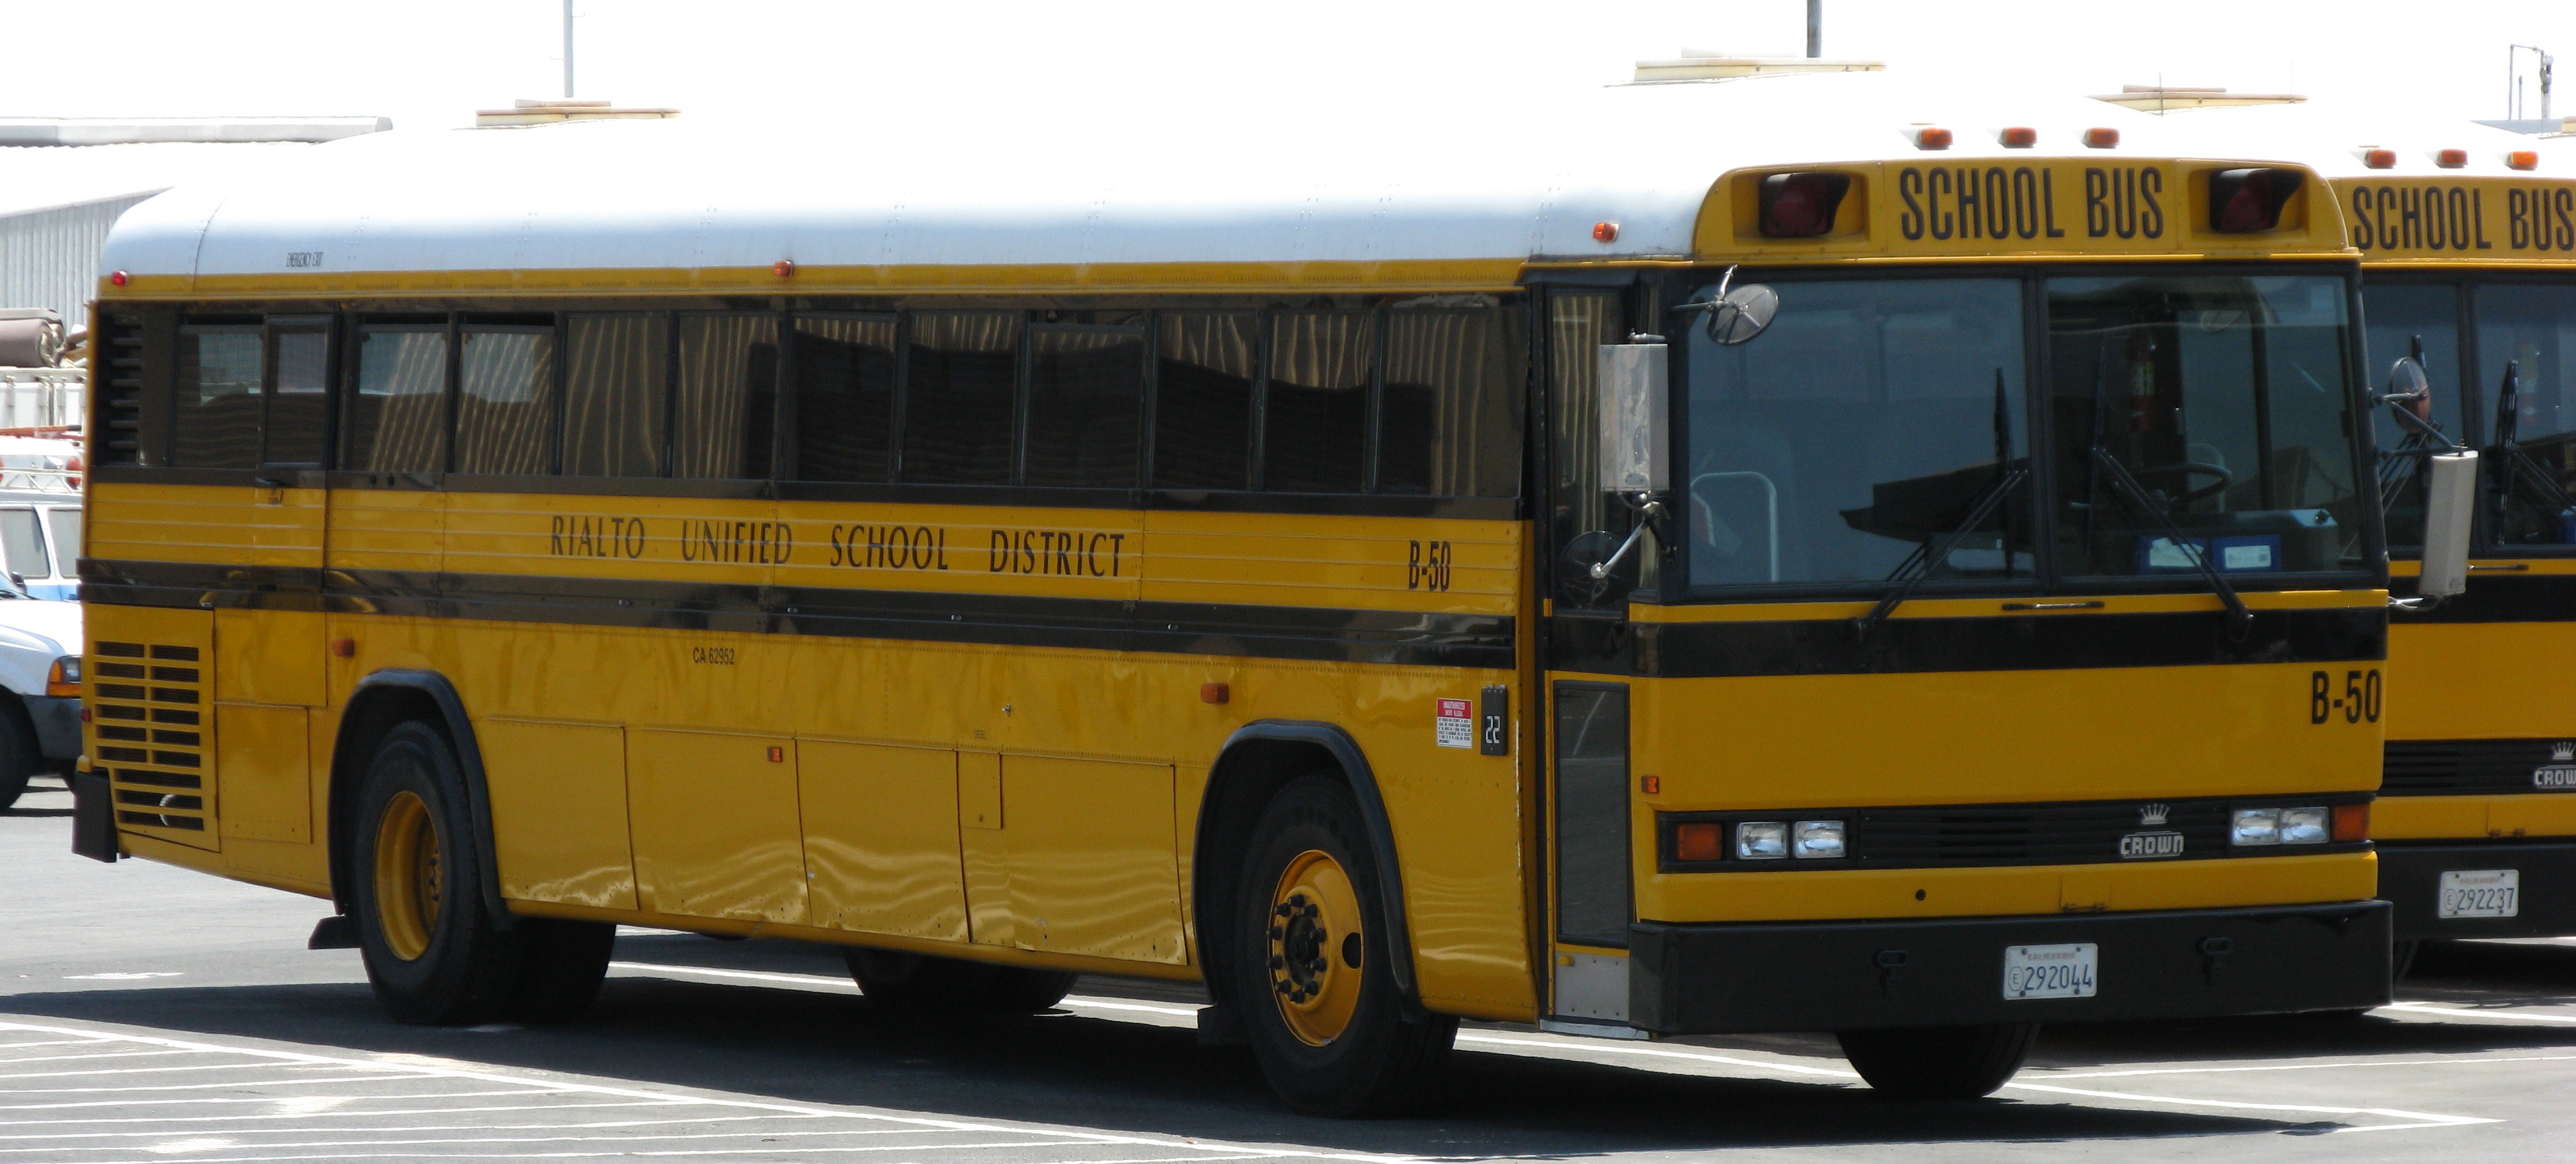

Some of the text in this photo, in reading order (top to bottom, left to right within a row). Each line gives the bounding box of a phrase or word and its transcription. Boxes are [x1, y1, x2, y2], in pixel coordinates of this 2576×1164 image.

[1899, 166, 2164, 241] SCHOOL BUS
[2353, 186, 2575, 251] SCHOOL BUS
[551, 515, 1125, 577] RIALTO UNIFIED SCHOOL DISTRICT
[1408, 540, 1451, 591] B-50
[693, 647, 734, 665] CA 62952
[2312, 668, 2382, 724] B-50
[1486, 715, 1501, 744] 22
[2121, 836, 2184, 855] CROWN
[2457, 888, 2515, 910] 292237
[2025, 964, 2092, 991] 292044
